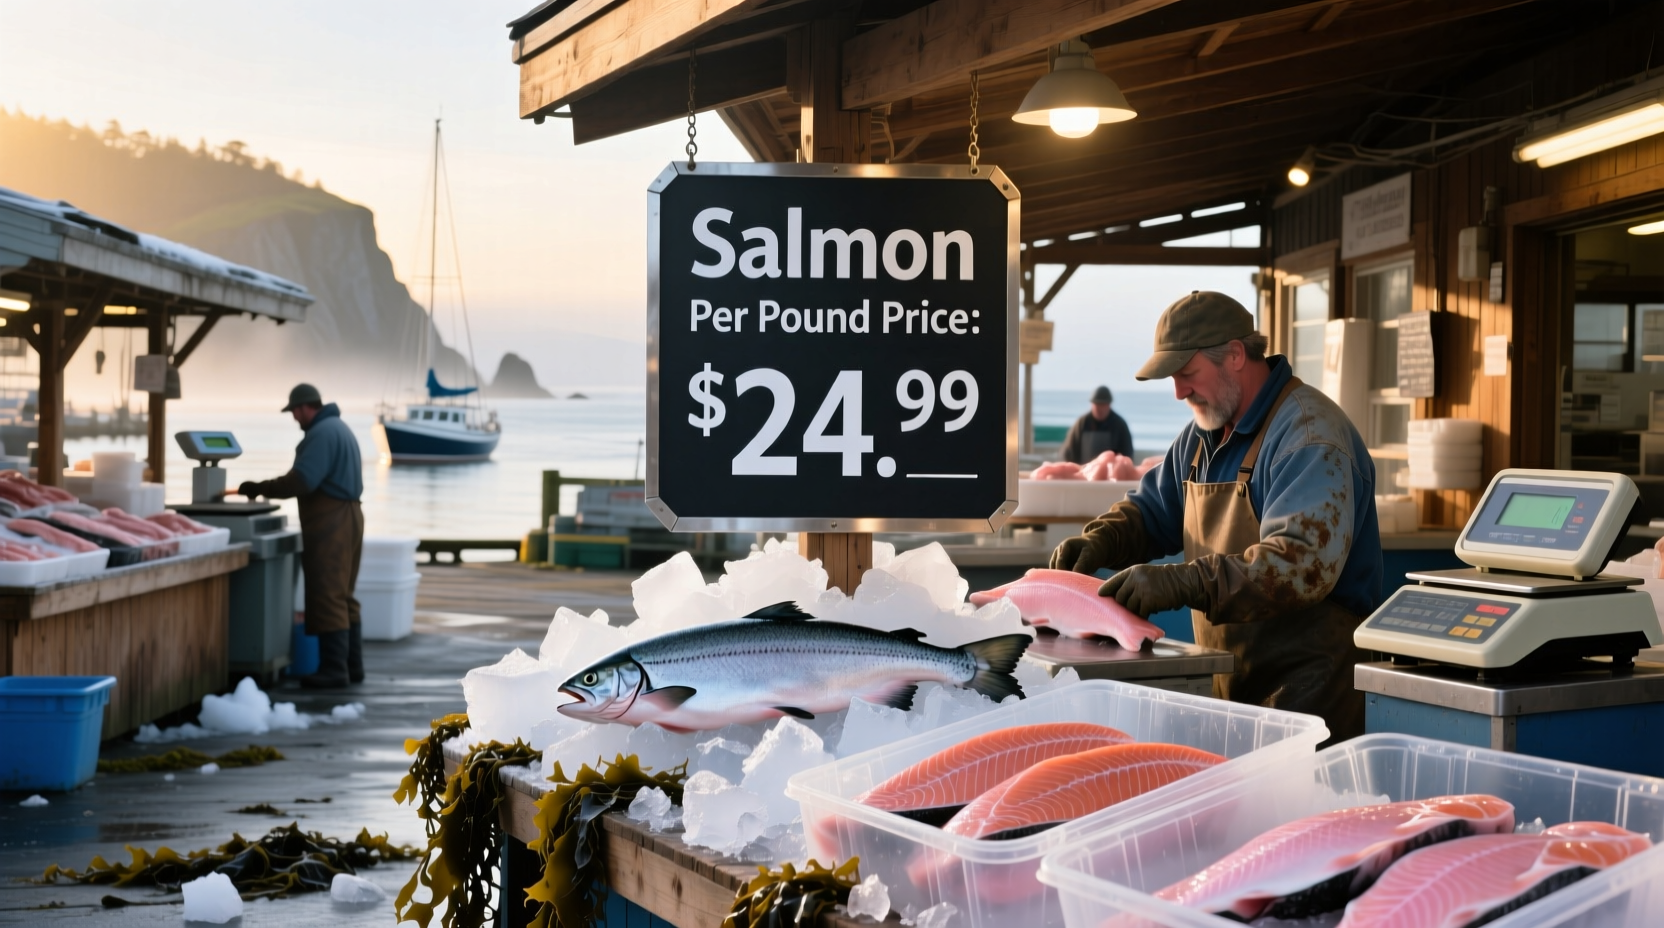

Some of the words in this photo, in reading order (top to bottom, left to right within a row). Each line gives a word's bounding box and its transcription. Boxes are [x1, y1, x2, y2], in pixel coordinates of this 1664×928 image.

[690, 206, 974, 281] Salmon
[690, 299, 749, 333] Per
[759, 298, 870, 334] Pound
[882, 299, 980, 335] Price:
